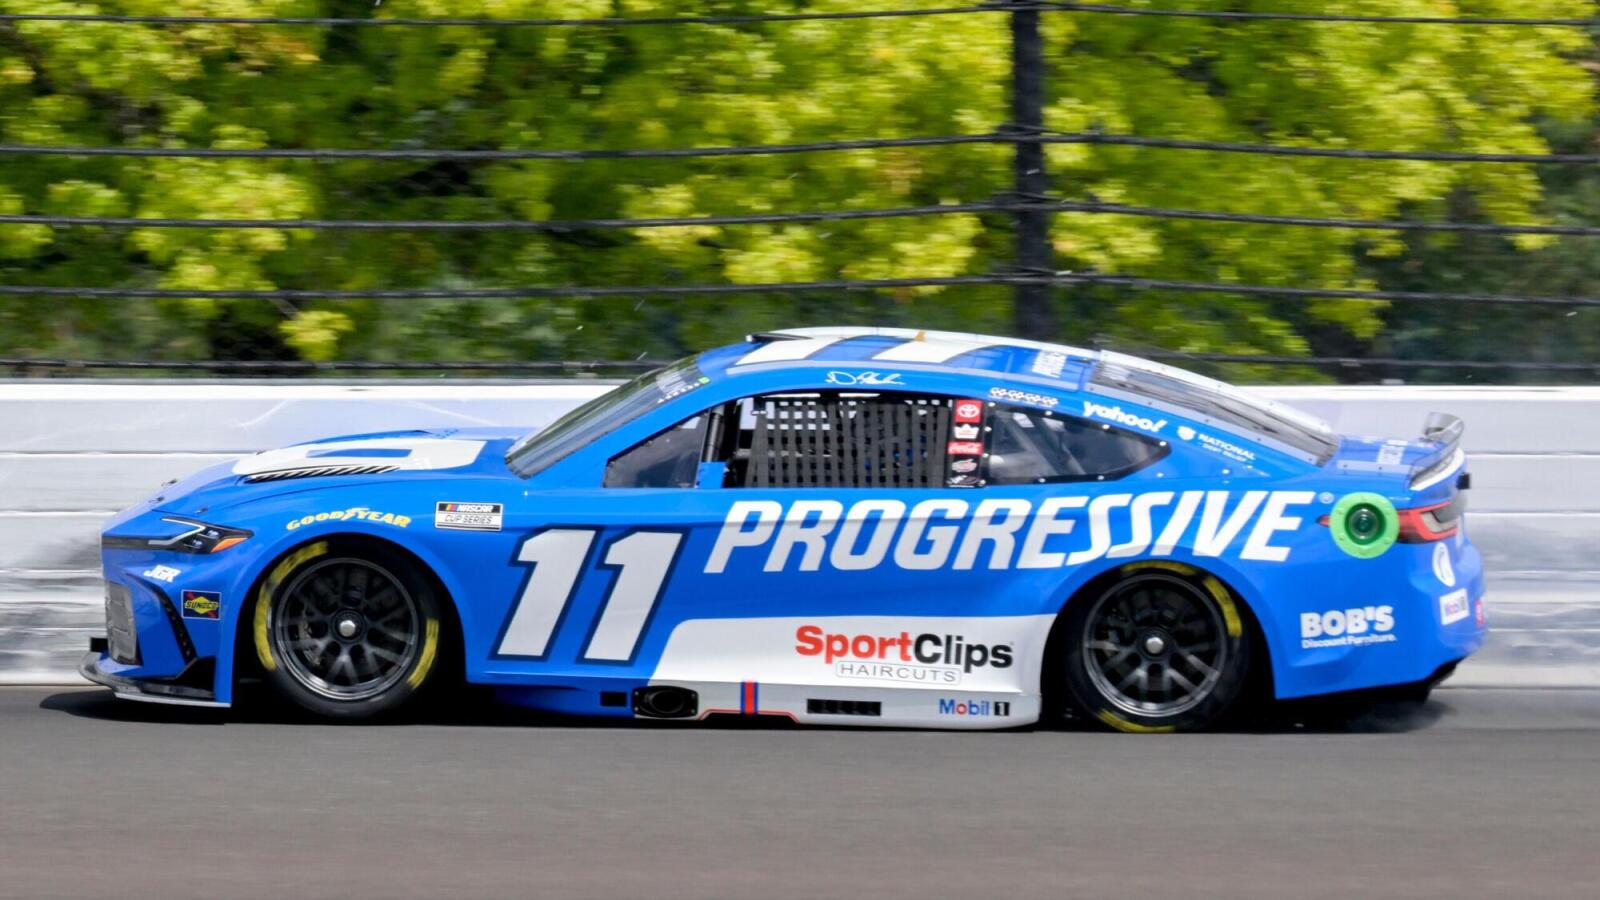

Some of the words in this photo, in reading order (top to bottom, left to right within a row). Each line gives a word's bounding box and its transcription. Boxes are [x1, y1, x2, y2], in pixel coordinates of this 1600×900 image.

[1083, 401, 1168, 433] yahoo!
[1198, 433, 1256, 460] NATIONAL
[286, 507, 412, 530] GOODYEAR
[444, 514, 462, 524] CUP
[463, 515, 493, 525] SERIES
[456, 504, 494, 513] NASCAR
[704, 491, 1315, 573] PROGRESSIVE
[143, 565, 181, 583] JGR
[184, 600, 219, 610] SUNOCO
[493, 526, 686, 662] 11
[1300, 605, 1395, 638] BOB'S
[795, 625, 1014, 674] SportClips
[840, 664, 957, 682] HAIRCUTS
[939, 699, 989, 716] Mobil
[994, 701, 1010, 716] 1
